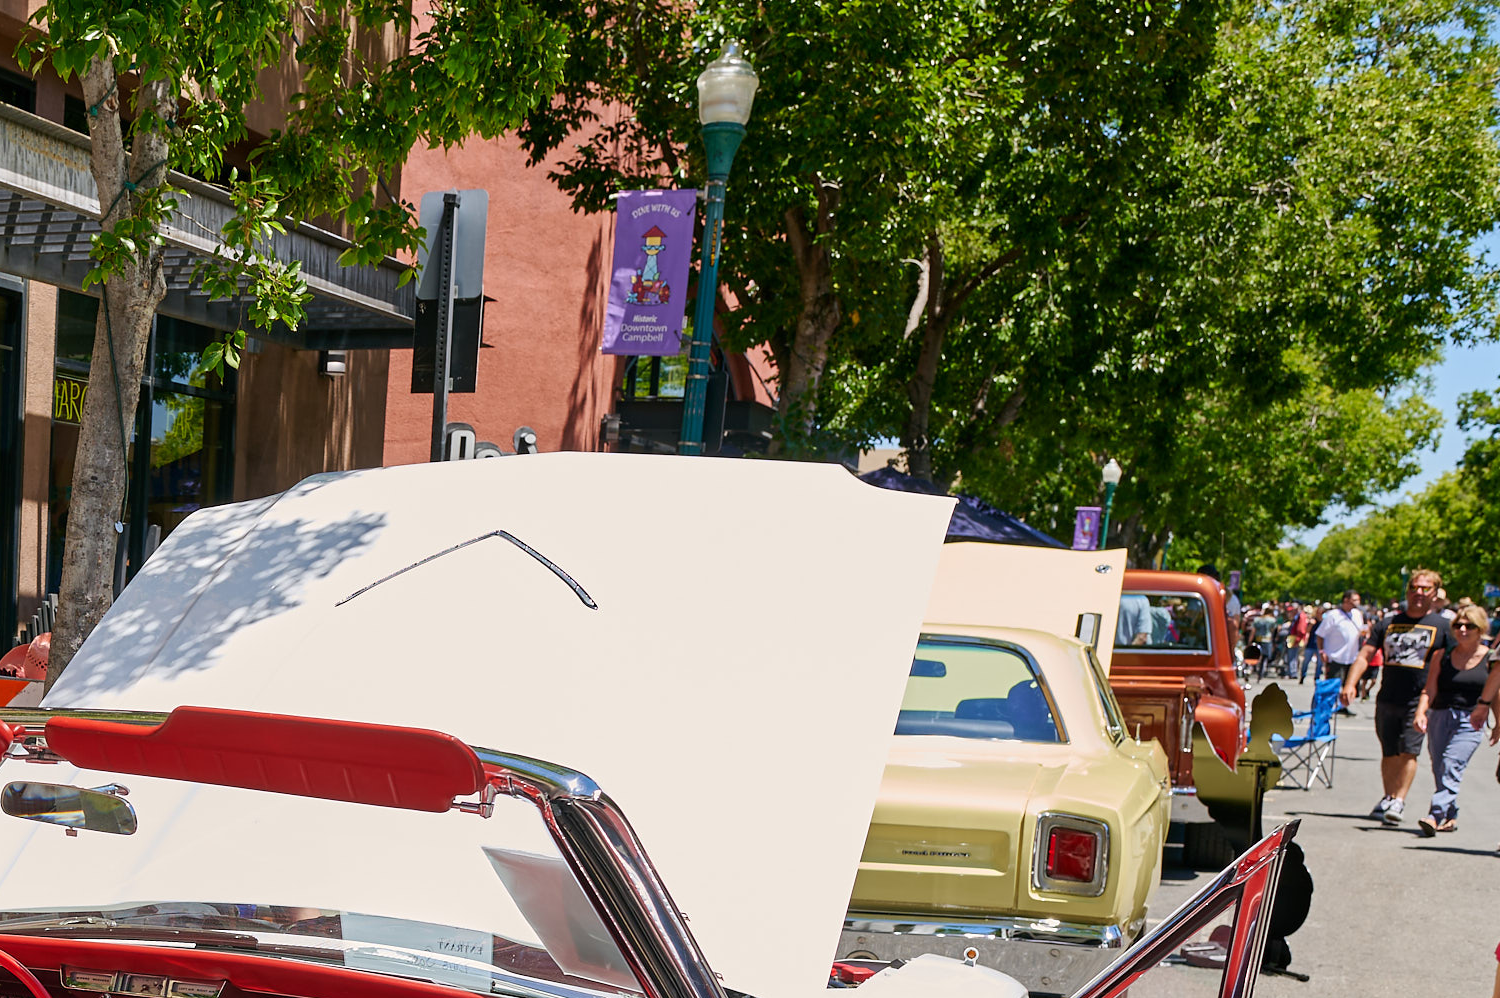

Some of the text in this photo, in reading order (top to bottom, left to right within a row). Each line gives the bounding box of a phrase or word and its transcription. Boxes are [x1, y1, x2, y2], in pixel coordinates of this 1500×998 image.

[621, 323, 668, 333] Downtown
[622, 332, 664, 343] Campbell
[166, 401, 195, 442] BAR
